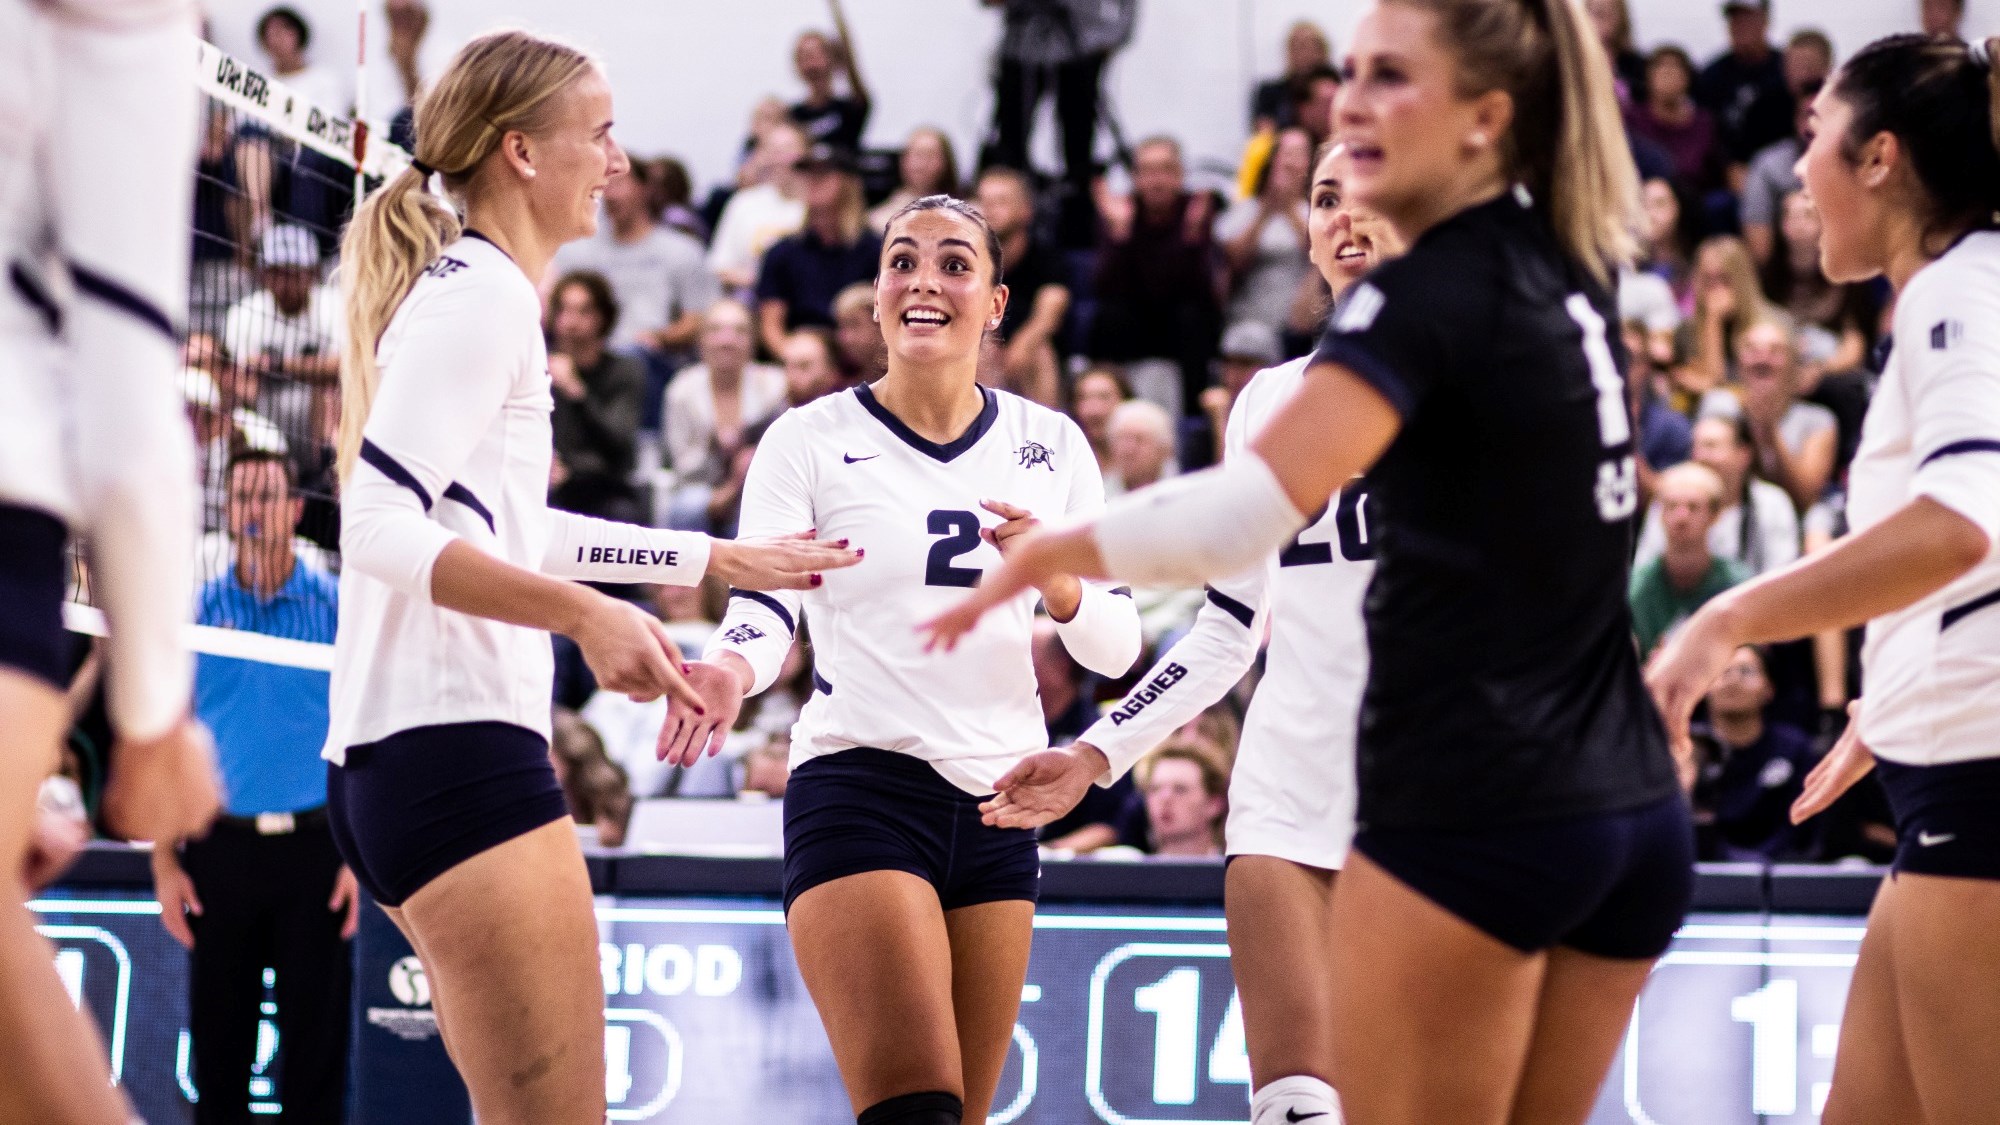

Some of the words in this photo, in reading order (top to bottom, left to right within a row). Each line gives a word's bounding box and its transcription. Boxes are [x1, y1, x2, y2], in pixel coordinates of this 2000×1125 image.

[577, 546, 584, 563] I
[590, 546, 679, 567] BELIEVE
[925, 509, 984, 588] 2
[1109, 661, 1189, 727] AGGIES
[599, 942, 743, 997] RIOD
